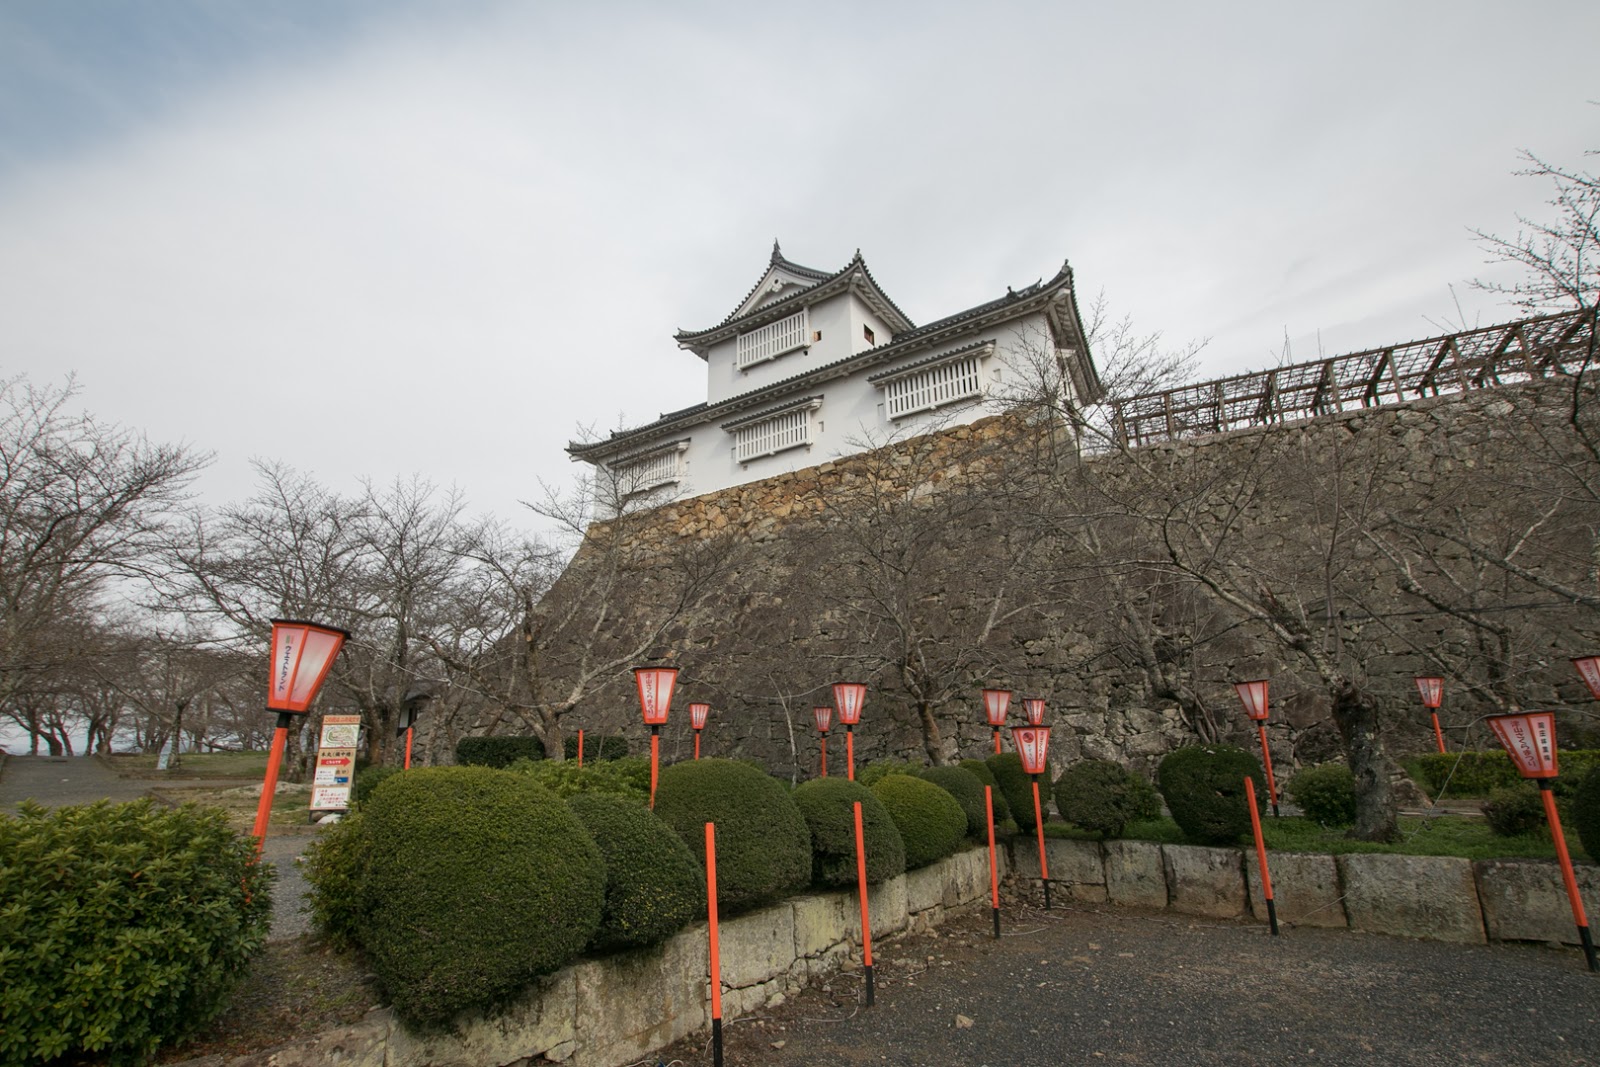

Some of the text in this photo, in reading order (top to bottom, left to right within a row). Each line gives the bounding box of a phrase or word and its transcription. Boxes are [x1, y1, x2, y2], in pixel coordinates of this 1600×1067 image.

[1510, 719, 1537, 768] 津山さくらまつり
